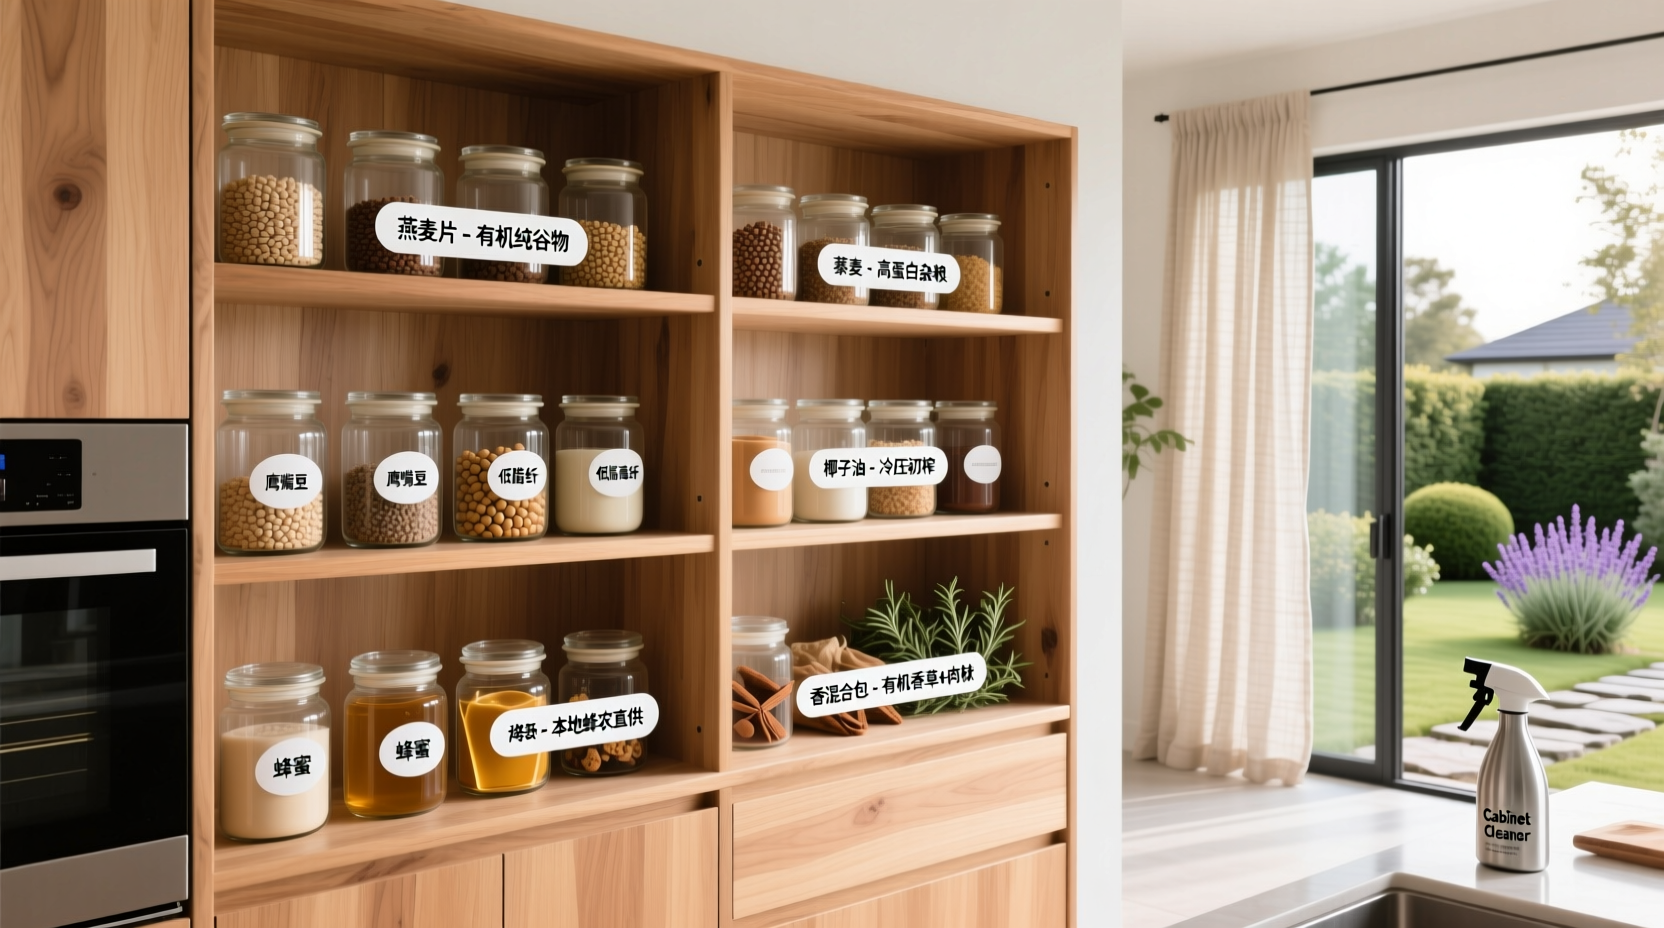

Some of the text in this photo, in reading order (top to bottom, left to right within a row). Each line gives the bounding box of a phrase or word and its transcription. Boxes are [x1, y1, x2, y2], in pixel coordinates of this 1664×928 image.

[397, 214, 458, 244] 燕麦片
[476, 224, 570, 253] 有机纯谷物
[1483, 807, 1532, 826] Cabinet
[1484, 824, 1532, 842] Cleaner
